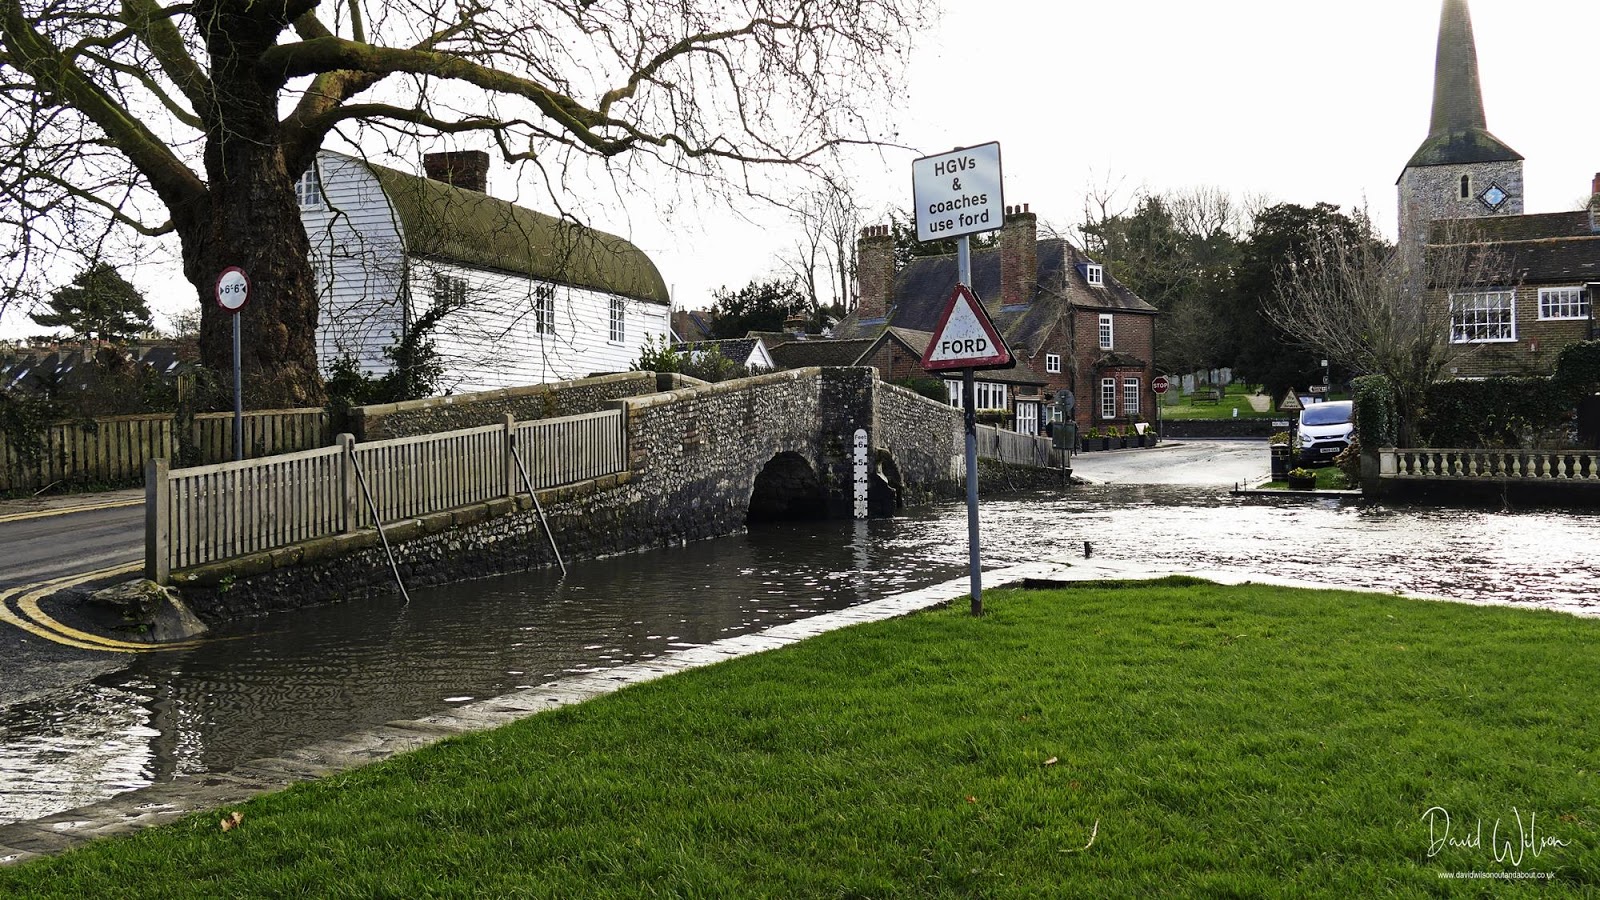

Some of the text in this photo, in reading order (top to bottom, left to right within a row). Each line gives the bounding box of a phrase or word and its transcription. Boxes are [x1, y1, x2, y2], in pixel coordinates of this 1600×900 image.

[934, 156, 976, 176] HGVs
[952, 177, 961, 191] &
[929, 193, 988, 214] coaches
[929, 208, 990, 233] use ford
[942, 338, 987, 355] FORD
